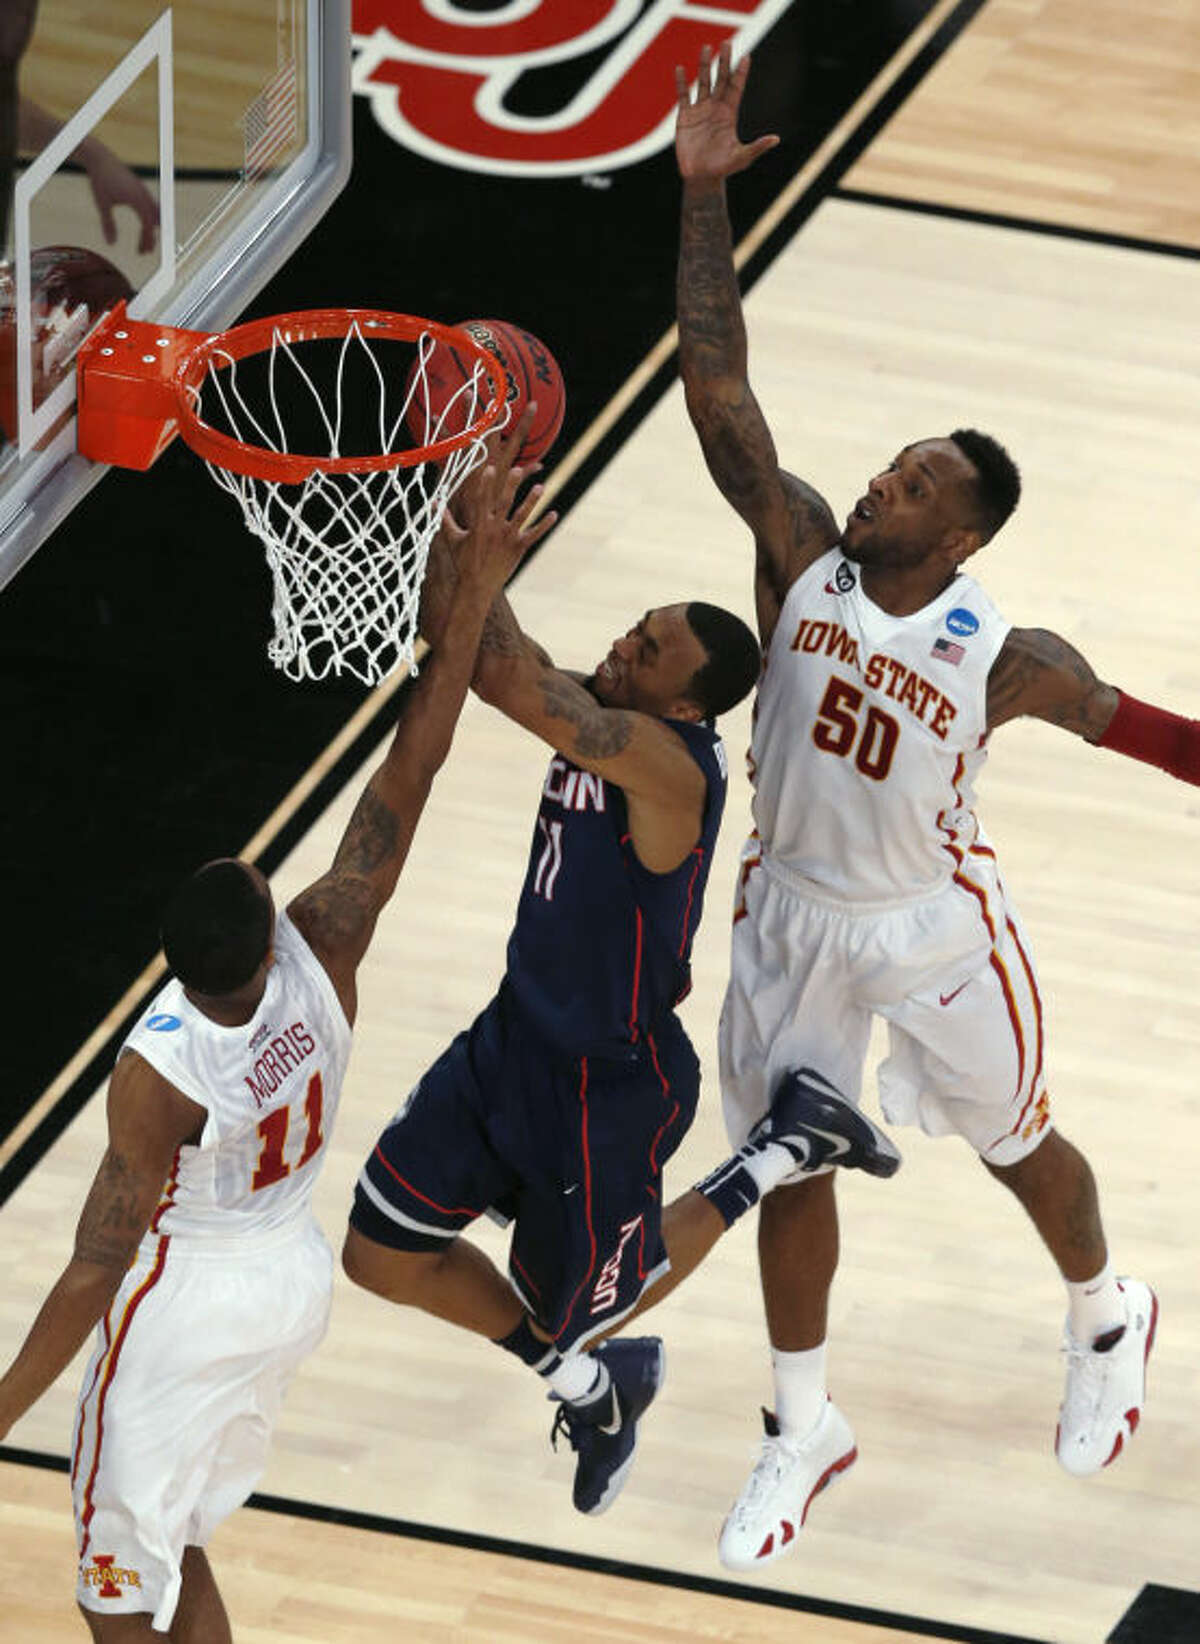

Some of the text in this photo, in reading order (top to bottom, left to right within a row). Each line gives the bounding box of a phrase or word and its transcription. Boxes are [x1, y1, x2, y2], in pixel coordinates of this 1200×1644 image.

[812, 674, 900, 782] 50
[863, 653, 957, 742] STATE
[243, 1021, 316, 1109] MORRIS
[250, 1069, 324, 1193] 11
